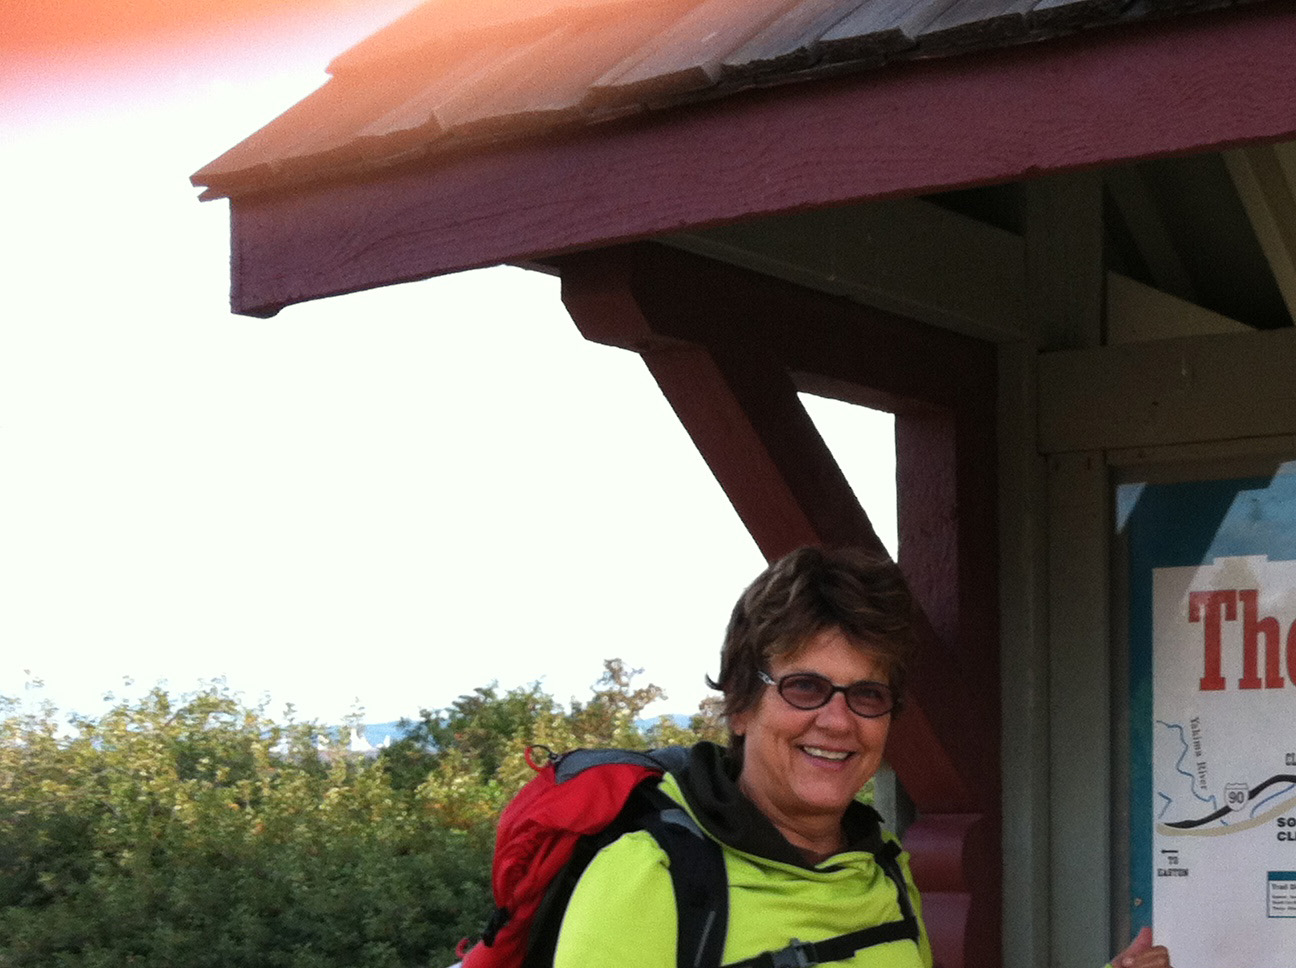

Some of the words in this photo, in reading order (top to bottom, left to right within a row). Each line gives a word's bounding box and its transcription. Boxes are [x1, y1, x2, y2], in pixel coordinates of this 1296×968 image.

[1190, 717, 1202, 757] Yakima
[1197, 761, 1207, 790] River
[1228, 791, 1244, 803] 90
